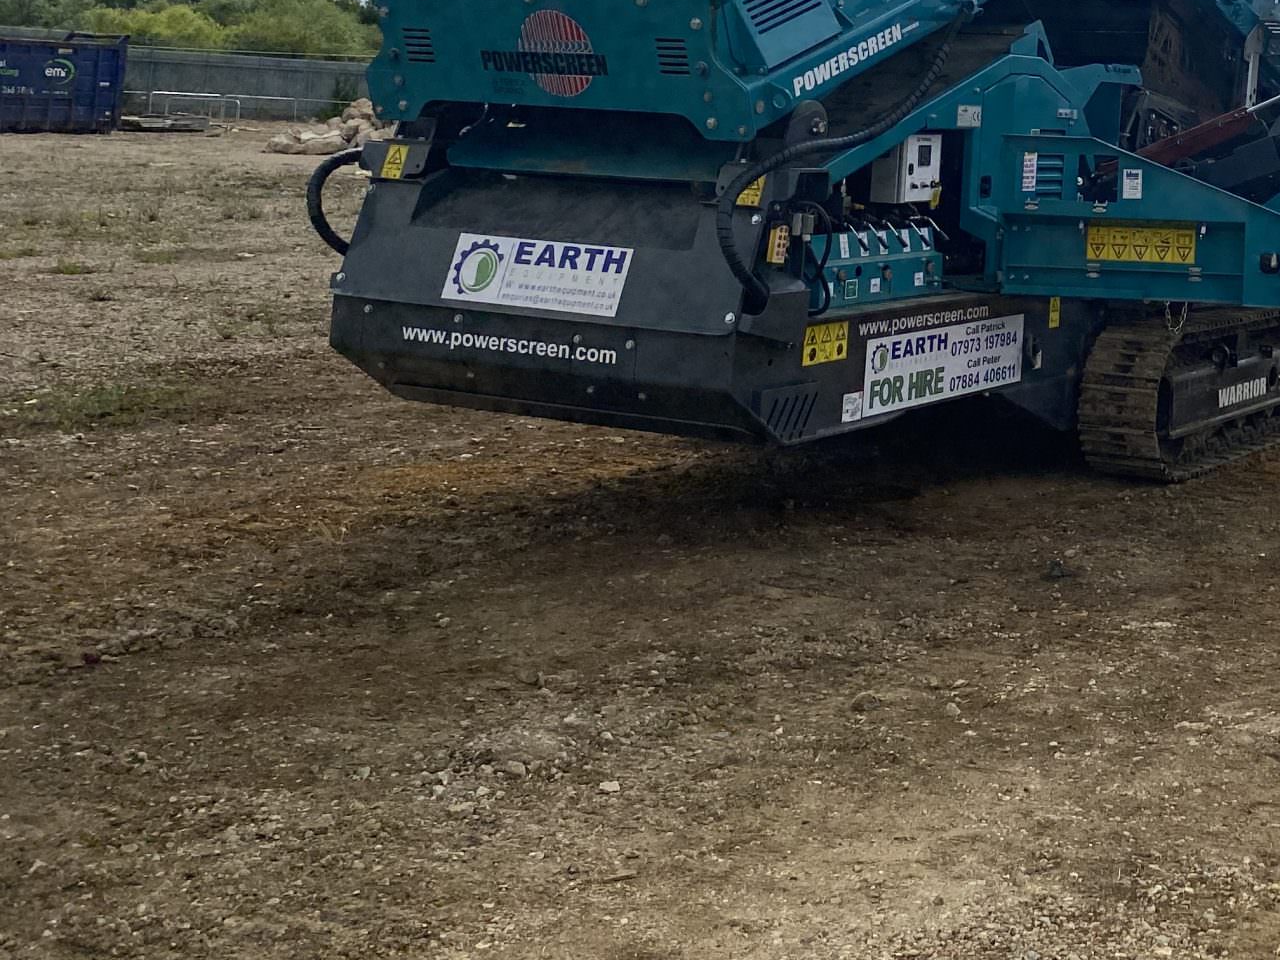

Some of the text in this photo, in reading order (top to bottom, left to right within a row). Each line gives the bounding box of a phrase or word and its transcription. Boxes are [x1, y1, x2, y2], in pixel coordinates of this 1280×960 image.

[480, 50, 608, 76] POWERSCREEN
[793, 23, 902, 97] POWERSCREEN
[514, 241, 627, 274] EARTH
[858, 304, 989, 337] www.powerscreen.com
[966, 321, 1005, 336] Call Patrick
[402, 326, 617, 365] www.powerscreen.com
[891, 332, 949, 360] EARTH
[951, 330, 1017, 357] 07973 197984
[967, 355, 1001, 369] Call Peter
[869, 366, 945, 410] FOR HIRE
[950, 364, 1016, 392] 07884 406611
[1218, 377, 1267, 409] WARRIOR
